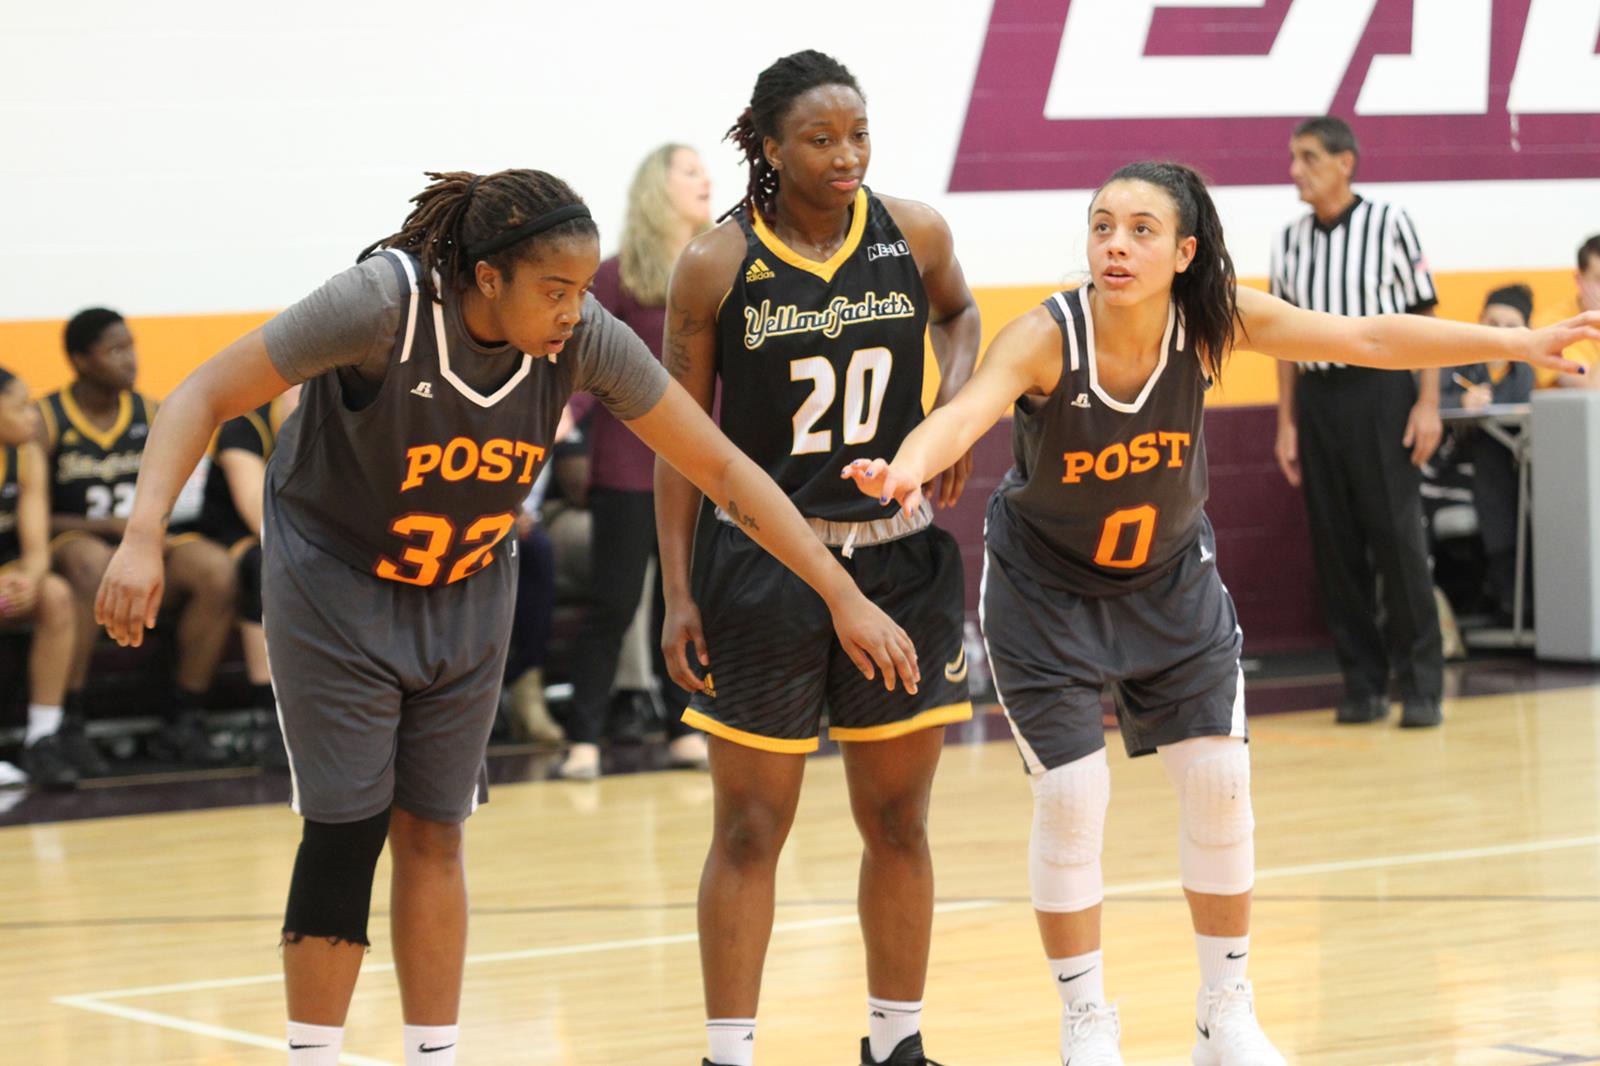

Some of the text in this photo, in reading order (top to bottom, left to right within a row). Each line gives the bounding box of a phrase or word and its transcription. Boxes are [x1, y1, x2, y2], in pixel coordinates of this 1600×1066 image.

[789, 346, 893, 456] 20
[400, 436, 546, 493] POST
[1061, 431, 1191, 484] POST
[373, 510, 516, 587] 32
[1093, 502, 1159, 569] 0
